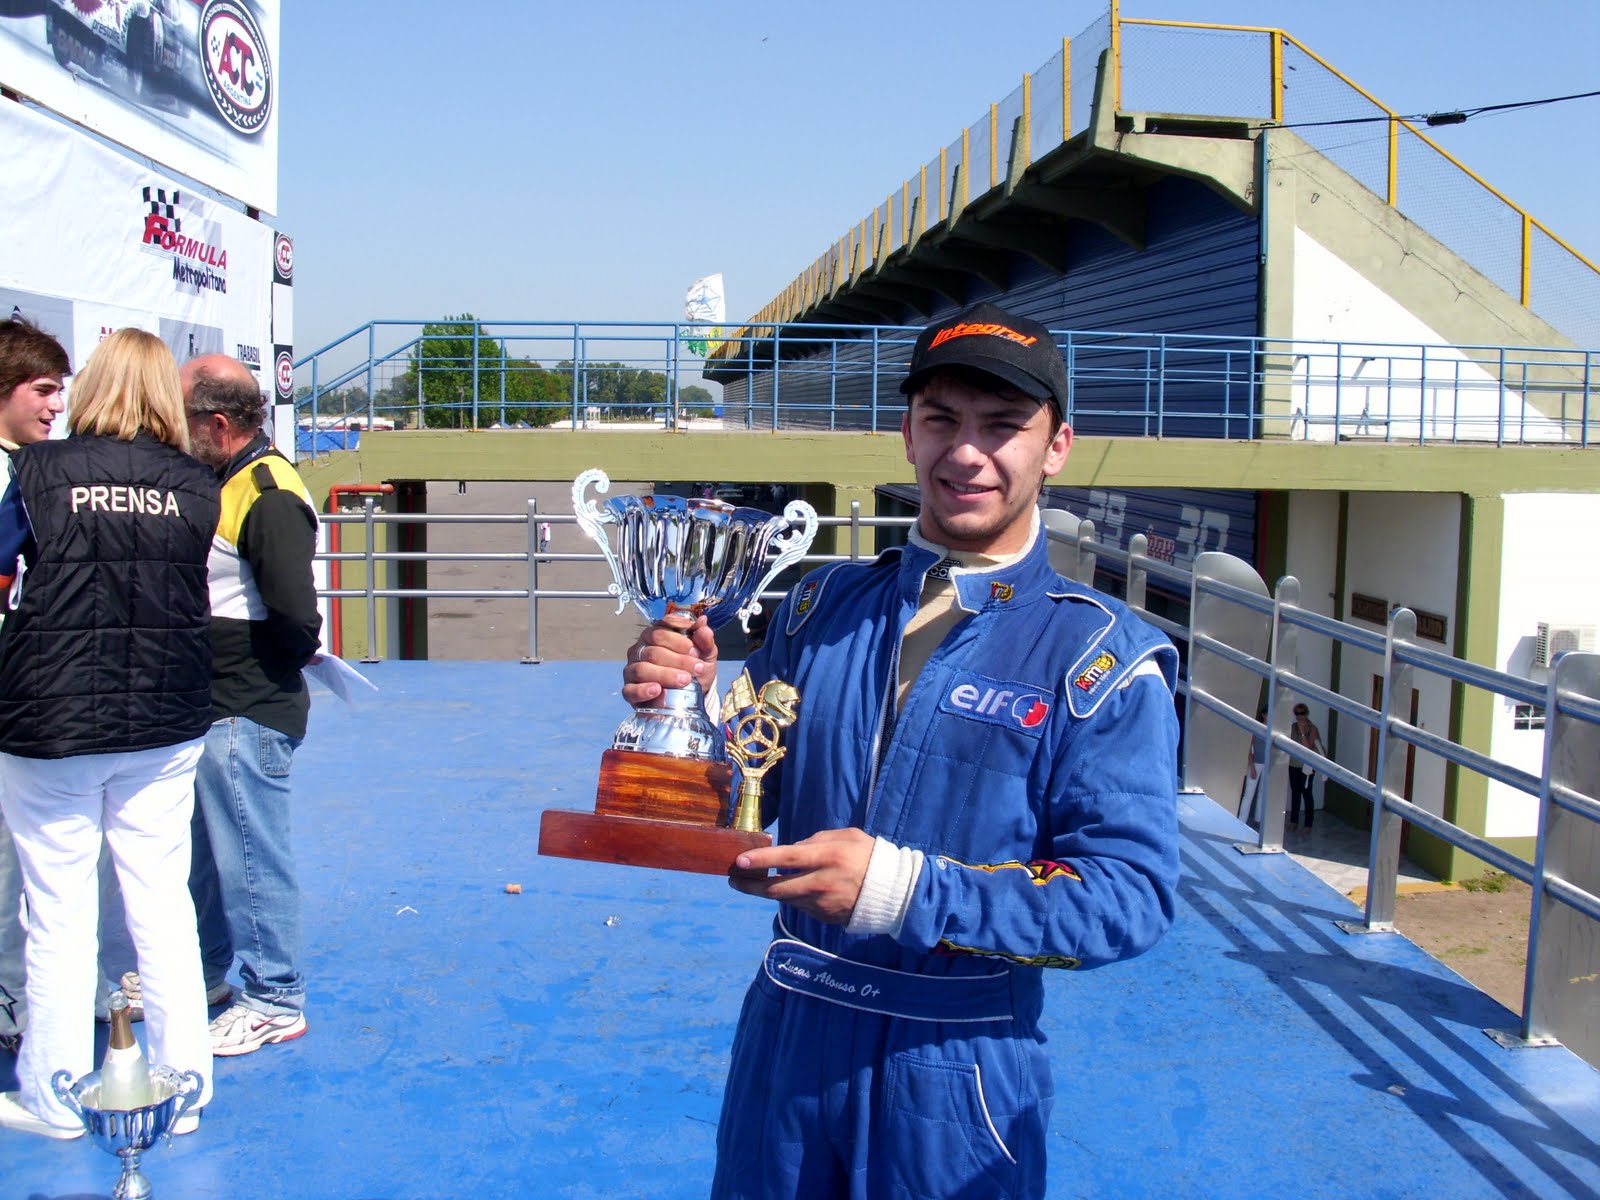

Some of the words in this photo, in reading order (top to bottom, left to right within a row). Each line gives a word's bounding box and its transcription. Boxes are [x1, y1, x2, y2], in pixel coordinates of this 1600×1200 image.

[218, 29, 255, 98] ACTC
[142, 212, 227, 270] FORMULA
[71, 485, 180, 517] PRENSA
[950, 684, 1014, 715] elf
[778, 957, 811, 979] Lucas
[813, 971, 856, 993] Alonso
